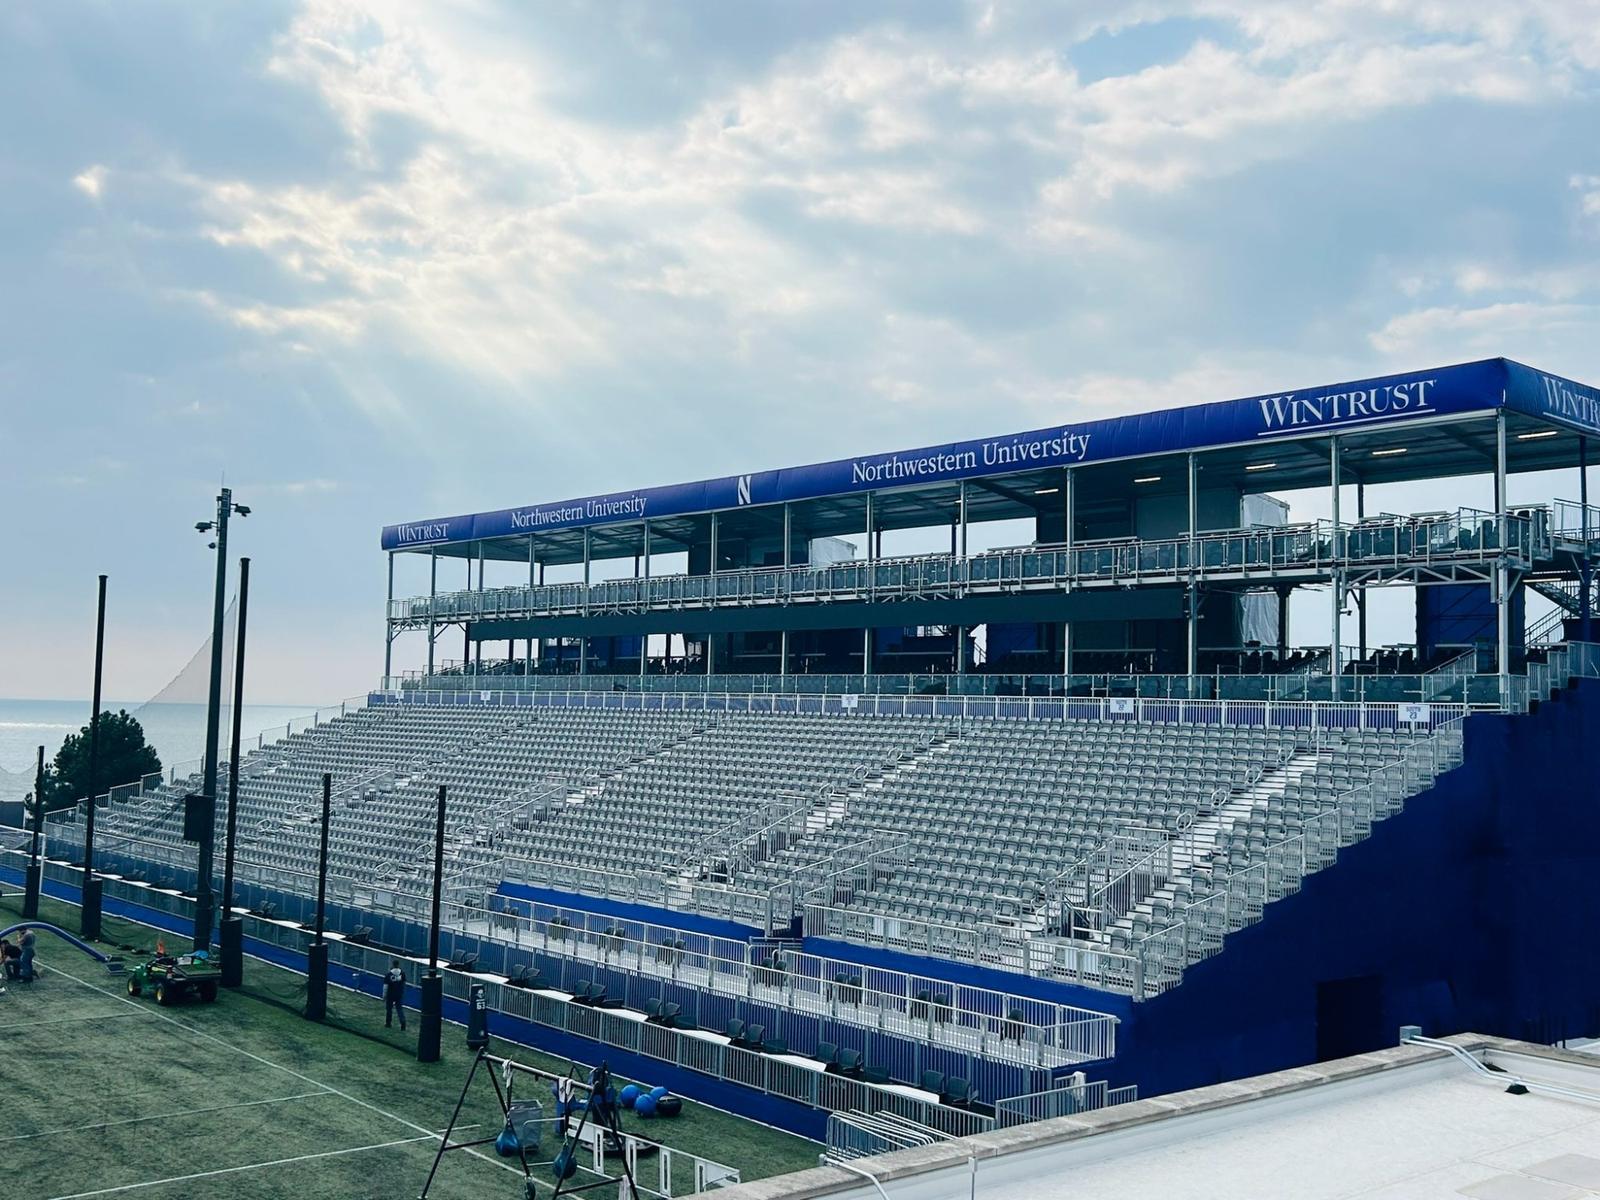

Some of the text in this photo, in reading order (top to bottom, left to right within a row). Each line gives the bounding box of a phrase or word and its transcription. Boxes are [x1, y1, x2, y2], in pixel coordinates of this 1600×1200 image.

[1259, 380, 1435, 428] WINTRUST
[1543, 376, 1600, 424] WINTR
[851, 431, 1091, 484] Northwestern University
[737, 475, 752, 505] N
[511, 494, 647, 528] Northwestern University
[398, 523, 449, 542] WINTRUST
